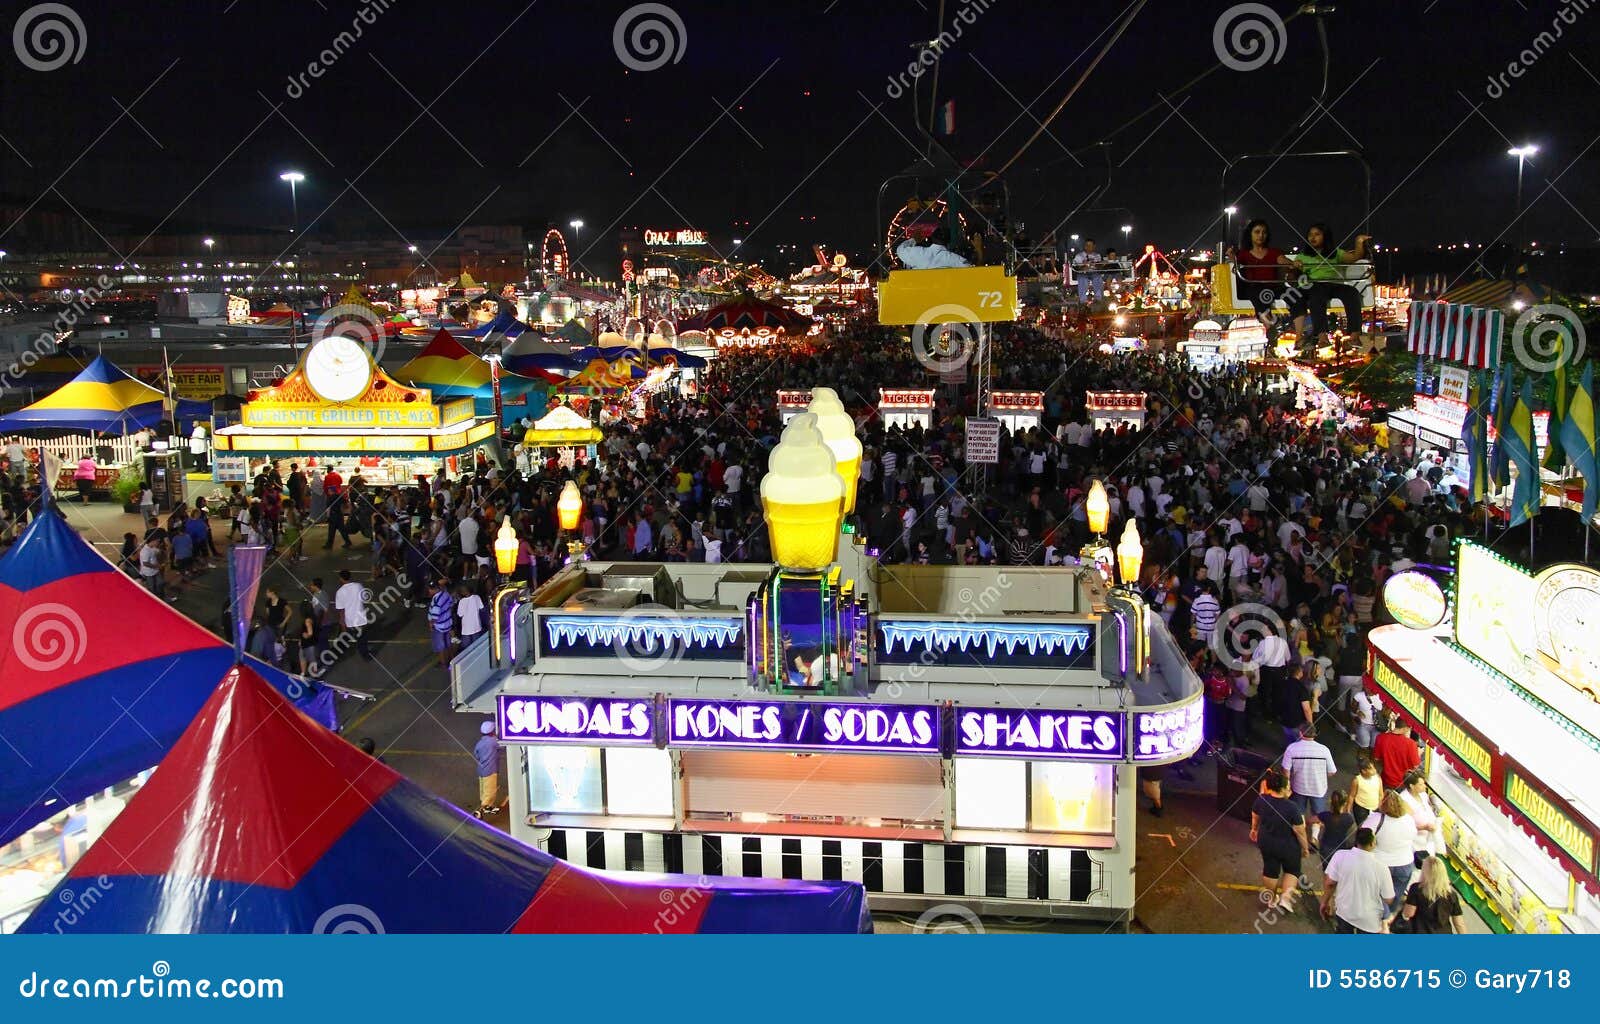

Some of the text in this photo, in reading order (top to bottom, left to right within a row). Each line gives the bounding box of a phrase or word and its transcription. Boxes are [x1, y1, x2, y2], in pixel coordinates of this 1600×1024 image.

[644, 229, 676, 246] CRAZ
[978, 291, 1003, 308] 72
[198, 374, 221, 384] FAIR
[784, 394, 812, 403] TICKE
[887, 394, 927, 404] TICKETS
[995, 396, 1036, 406] TICKETS
[1097, 397, 1138, 407] TICKETS
[247, 409, 316, 422] AUTHENTIC
[321, 409, 374, 422] GRILLED
[378, 409, 435, 423] TEX-MEX
[1378, 659, 1426, 717] BROCCOLI
[506, 699, 650, 736] SUNDAES
[675, 704, 781, 741] KONES
[824, 708, 932, 745] SODAS
[961, 711, 1117, 751] SHAKES
[1431, 706, 1492, 773] CAULIFLOWER
[1511, 777, 1593, 864] MUSHROOMS
